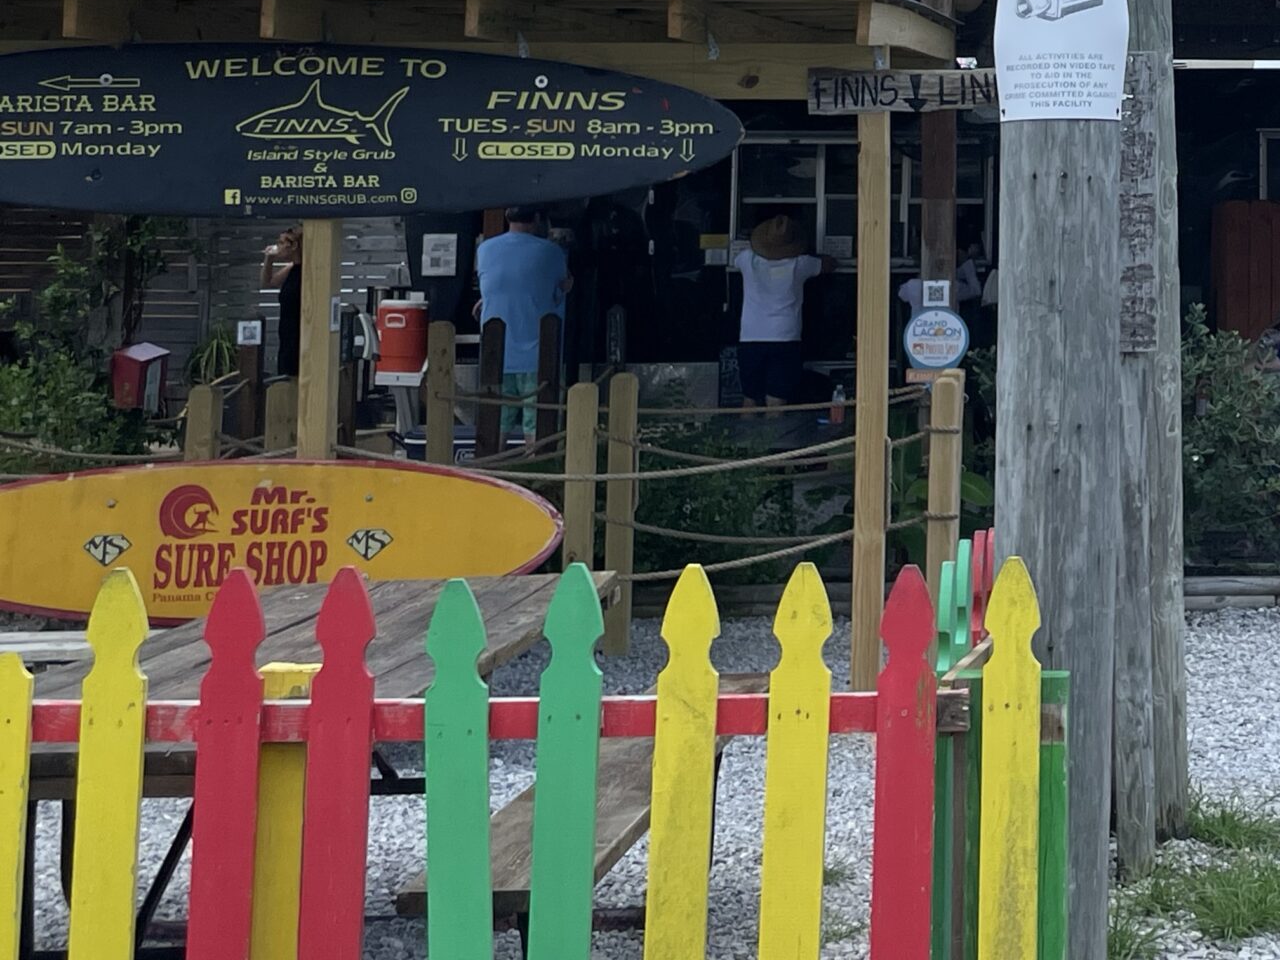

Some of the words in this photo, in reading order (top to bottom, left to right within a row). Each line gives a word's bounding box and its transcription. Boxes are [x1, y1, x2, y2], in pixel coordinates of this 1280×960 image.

[185, 56, 384, 79] WELCOME
[400, 58, 447, 78] TO
[1006, 62, 1050, 71] RECORDED
[1053, 62, 1067, 70] ON
[1070, 62, 1096, 70] VIDEO
[1099, 63, 1115, 71] TAPE
[1031, 71, 1042, 80] TO
[1044, 71, 1060, 79] AID
[1062, 71, 1073, 79] IN
[1076, 71, 1092, 79] THE
[814, 74, 899, 109] FINNS
[939, 72, 998, 105] LIN
[1014, 81, 1076, 90] PROSECUTION
[0, 95, 94, 112] ARISTA
[102, 94, 156, 111] BAR
[486, 91, 627, 110] FINNS
[1031, 100, 1050, 108] THIS
[1053, 100, 1092, 108] FACILITY
[1, 121, 54, 136] SUN
[60, 121, 112, 135] 7am
[130, 121, 183, 139] 3pm
[254, 118, 353, 133] FINNS
[438, 118, 507, 133] TUES
[526, 119, 576, 133] SUN
[586, 119, 640, 134] 8am
[660, 119, 714, 139] 3pm
[61, 142, 161, 158] Monday
[247, 149, 298, 160] Island
[303, 149, 347, 162] Style
[352, 149, 396, 160] Grub
[481, 144, 572, 157] CLOSED
[580, 143, 674, 160] Monday
[313, 162, 327, 173] &
[260, 176, 337, 188] BARISTA
[343, 175, 380, 187] BAR
[245, 194, 398, 205] www.FINNSGRUB.com
[915, 319, 947, 327] GRAND
[251, 486, 316, 505] Mr.
[231, 507, 329, 536] SURF'S
[153, 543, 236, 590] SURF
[246, 540, 328, 586] SHOP
